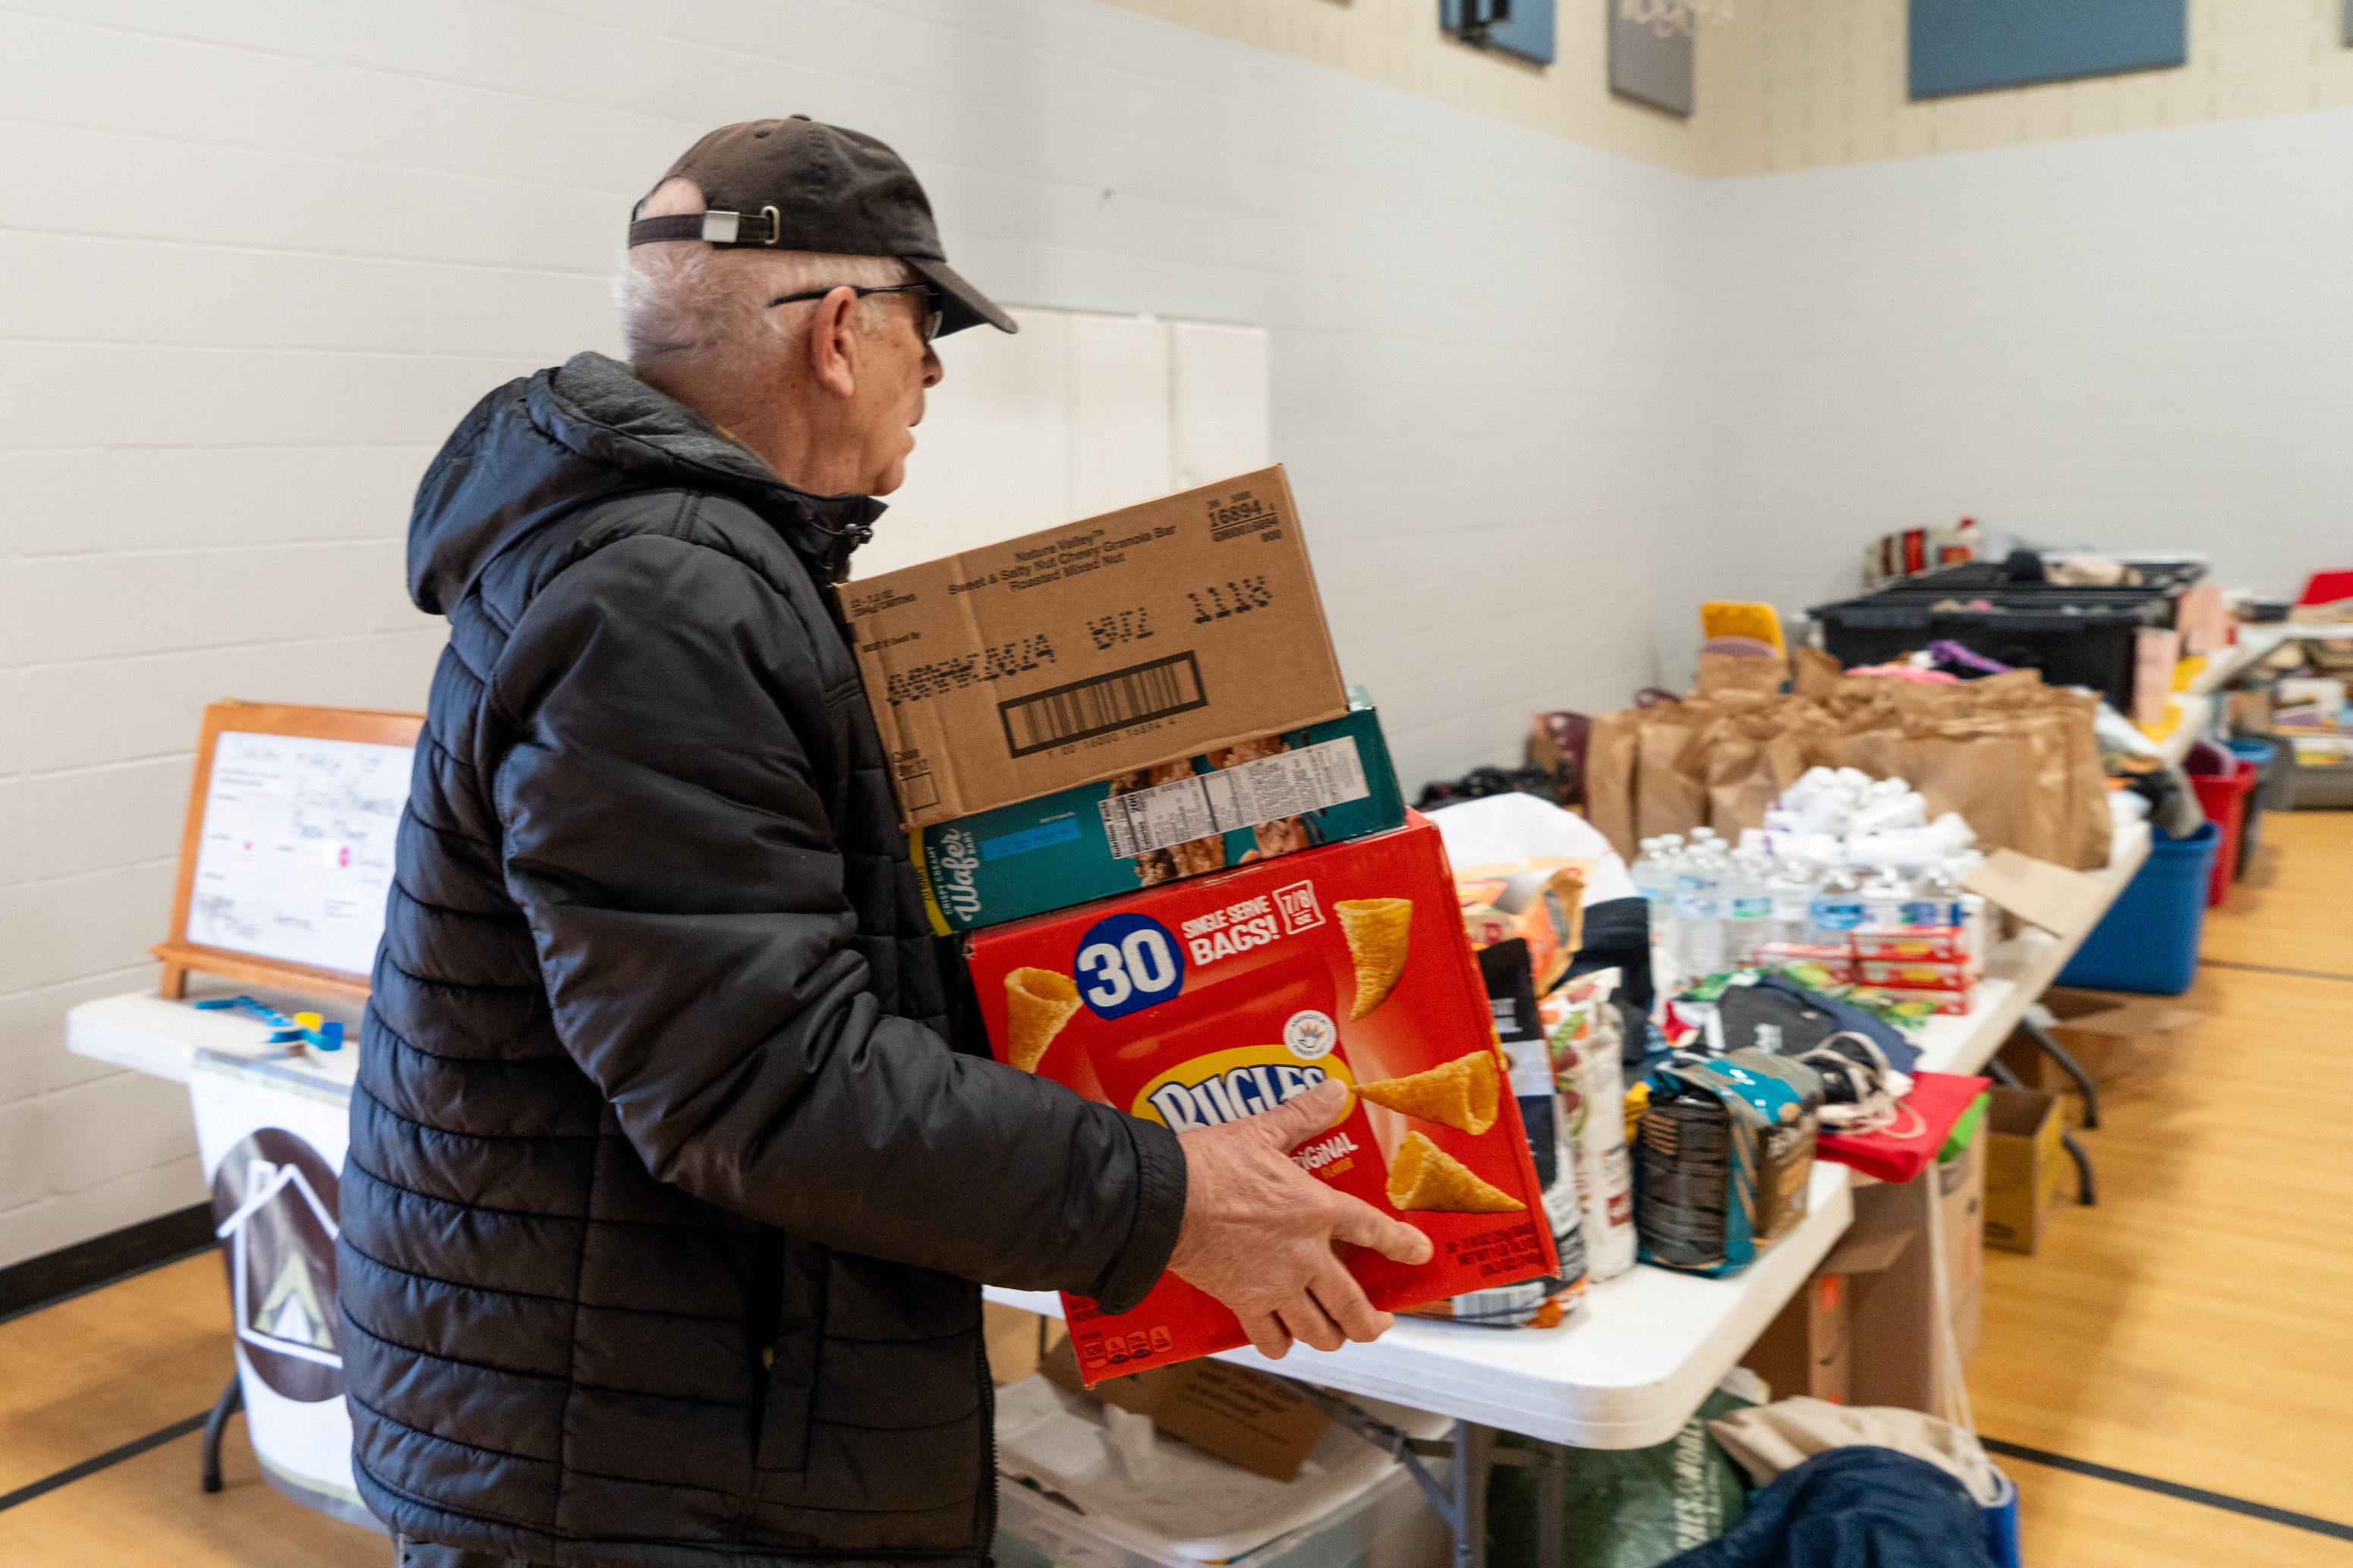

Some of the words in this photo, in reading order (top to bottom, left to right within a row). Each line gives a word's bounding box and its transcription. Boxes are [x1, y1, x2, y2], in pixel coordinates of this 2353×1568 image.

[948, 576, 988, 596] Sweet
[1000, 565, 1032, 581] Salty
[1033, 557, 1057, 571] Nut
[1058, 546, 1100, 565] Chewy
[1103, 532, 1152, 553] Granola
[1153, 525, 1176, 539] Bar
[1009, 571, 1061, 592] Roasted
[1101, 553, 1126, 566] Nut
[1014, 546, 1057, 562] Nature
[962, 831, 976, 855] BARS
[926, 846, 943, 882] CREAMY
[940, 828, 982, 922] Wafer
[937, 884, 953, 915] CRISPY
[1181, 910, 1230, 939] SINGLE
[1226, 896, 1272, 924] SERVE
[1281, 889, 1313, 915] 7/8
[1189, 915, 1281, 966] BAGS!
[1077, 929, 1176, 1007] 30
